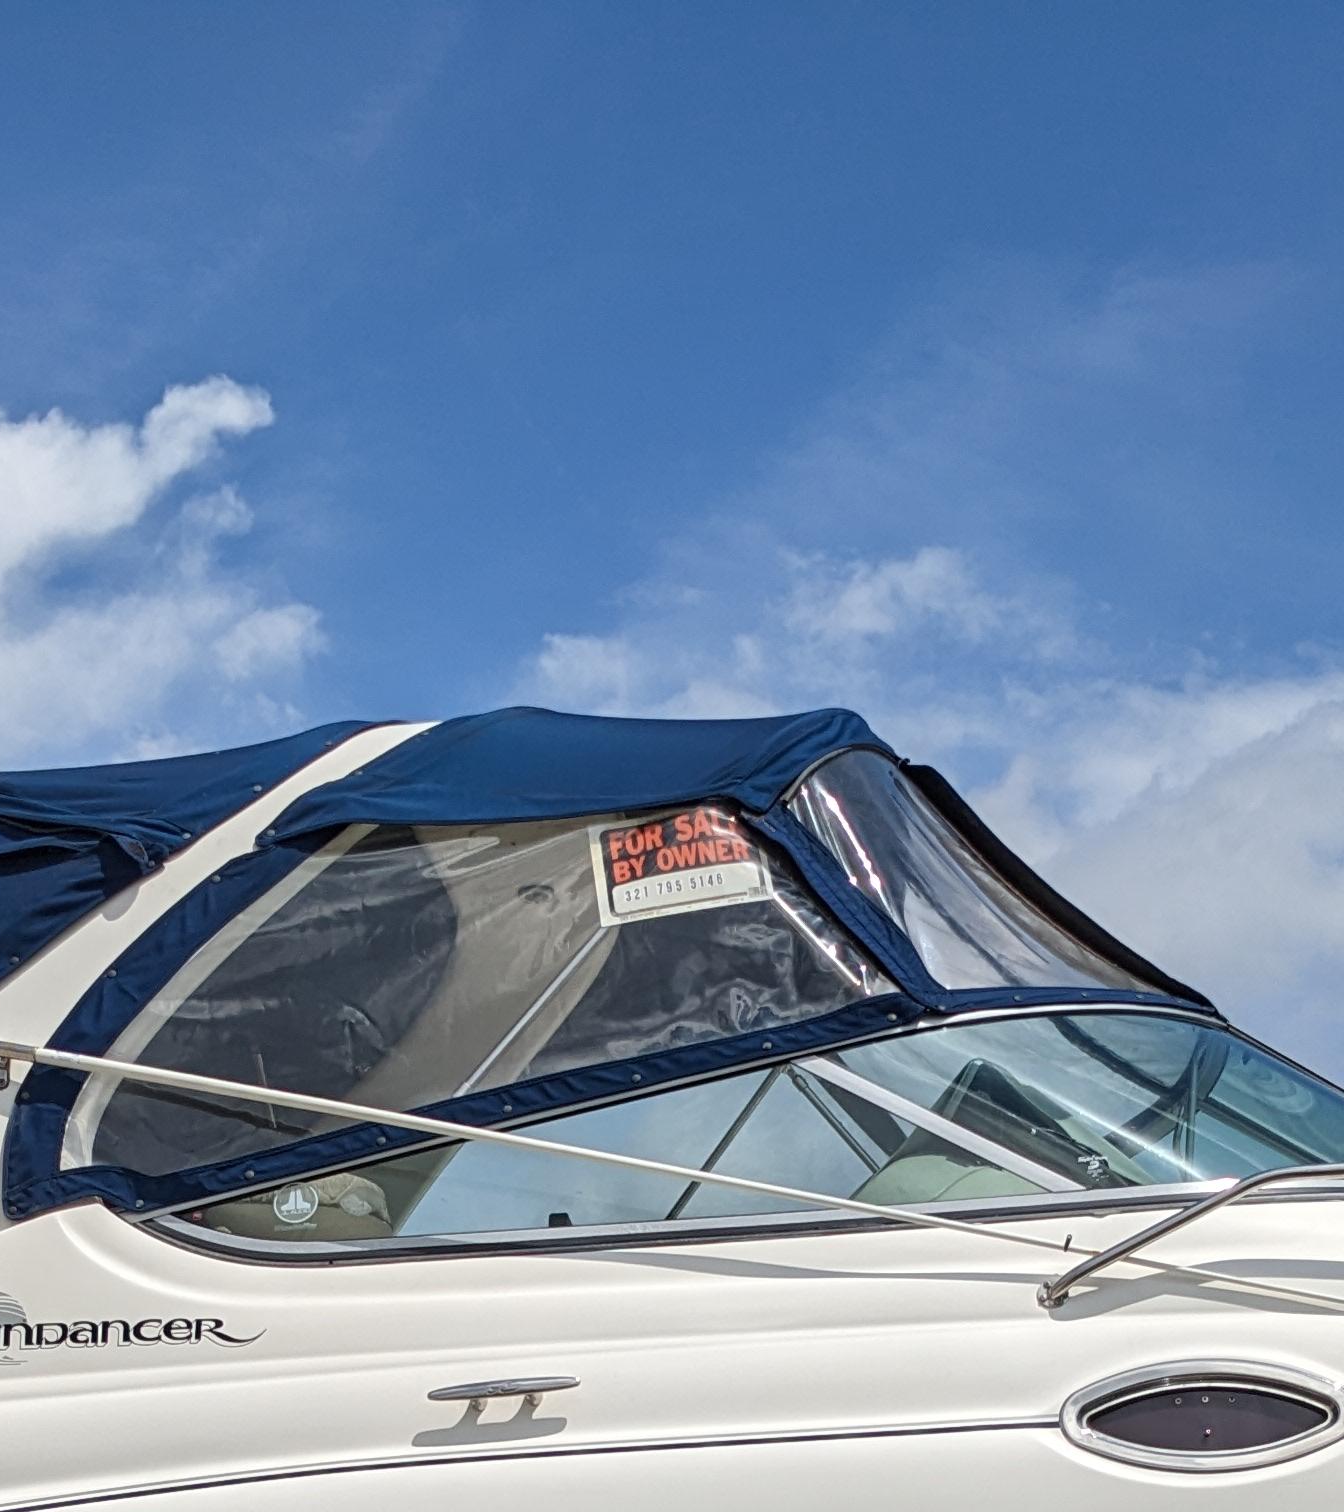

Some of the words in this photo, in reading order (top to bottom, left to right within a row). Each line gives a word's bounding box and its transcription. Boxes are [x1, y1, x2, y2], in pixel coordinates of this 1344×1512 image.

[609, 825, 664, 860] FOR
[612, 856, 646, 884] BY
[657, 838, 750, 872] OWNER
[625, 886, 649, 902] 321
[657, 879, 683, 895] 795
